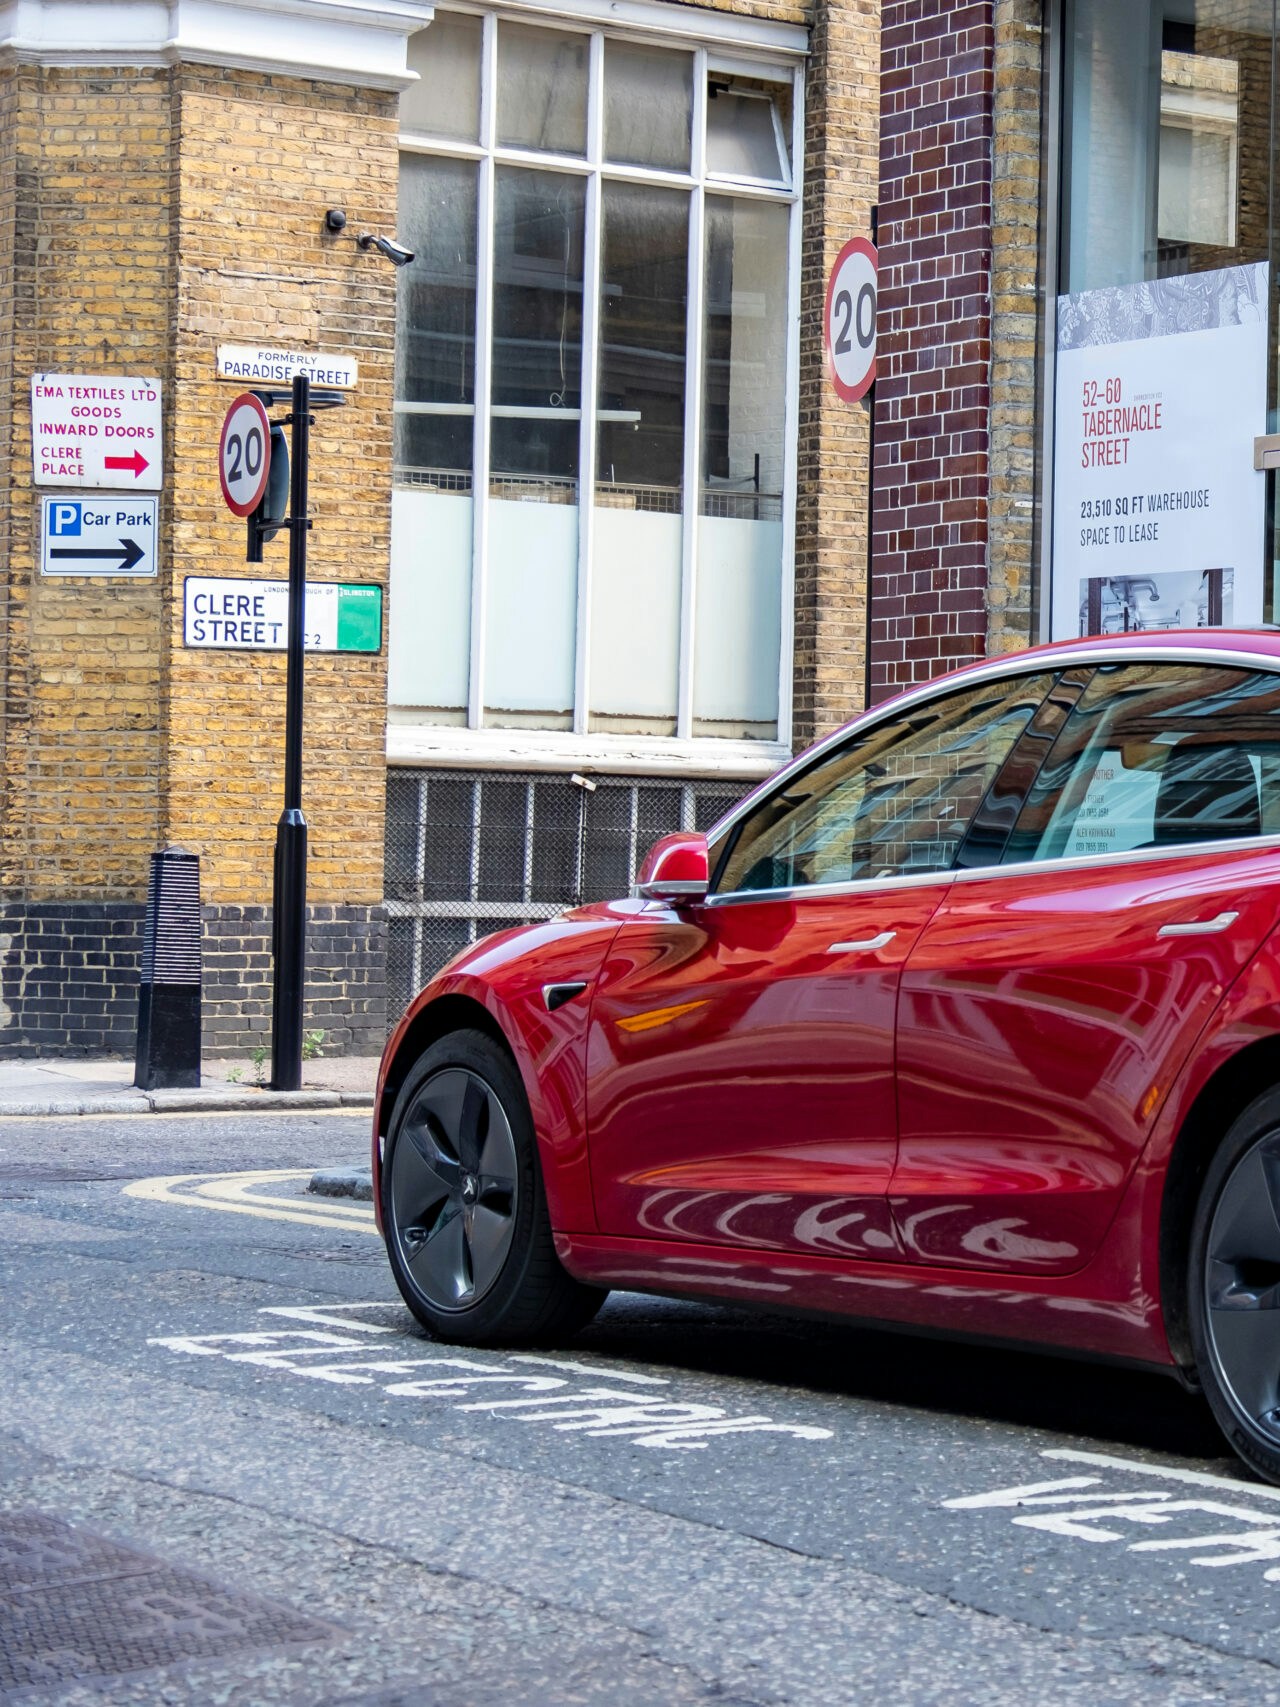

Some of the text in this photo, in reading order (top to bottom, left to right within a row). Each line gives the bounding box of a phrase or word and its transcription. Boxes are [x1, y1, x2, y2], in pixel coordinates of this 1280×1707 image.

[834, 282, 877, 355] 20
[258, 352, 317, 365] FORMERLY
[224, 361, 350, 385] PARADISE STREET
[36, 386, 157, 401] EMA TEXTILES LTD
[1083, 377, 1121, 407] 52-60
[71, 406, 121, 418] GOODS
[1082, 403, 1162, 437] TABERNACLE
[40, 423, 155, 438] INWARD DOORS
[41, 447, 82, 459] CLERE
[227, 427, 262, 483] 20
[1081, 438, 1130, 468] STREET
[42, 463, 84, 476] PLACE
[1081, 489, 1210, 519] 23,510 SQ FT WAREHOUSE
[83, 512, 111, 526] Car
[116, 512, 152, 526] Park
[1080, 522, 1159, 546] SPACE TO LEASE
[193, 594, 265, 617] CLERE
[193, 619, 283, 643] STREET
[146, 1329, 835, 1449] ELECTRIC
